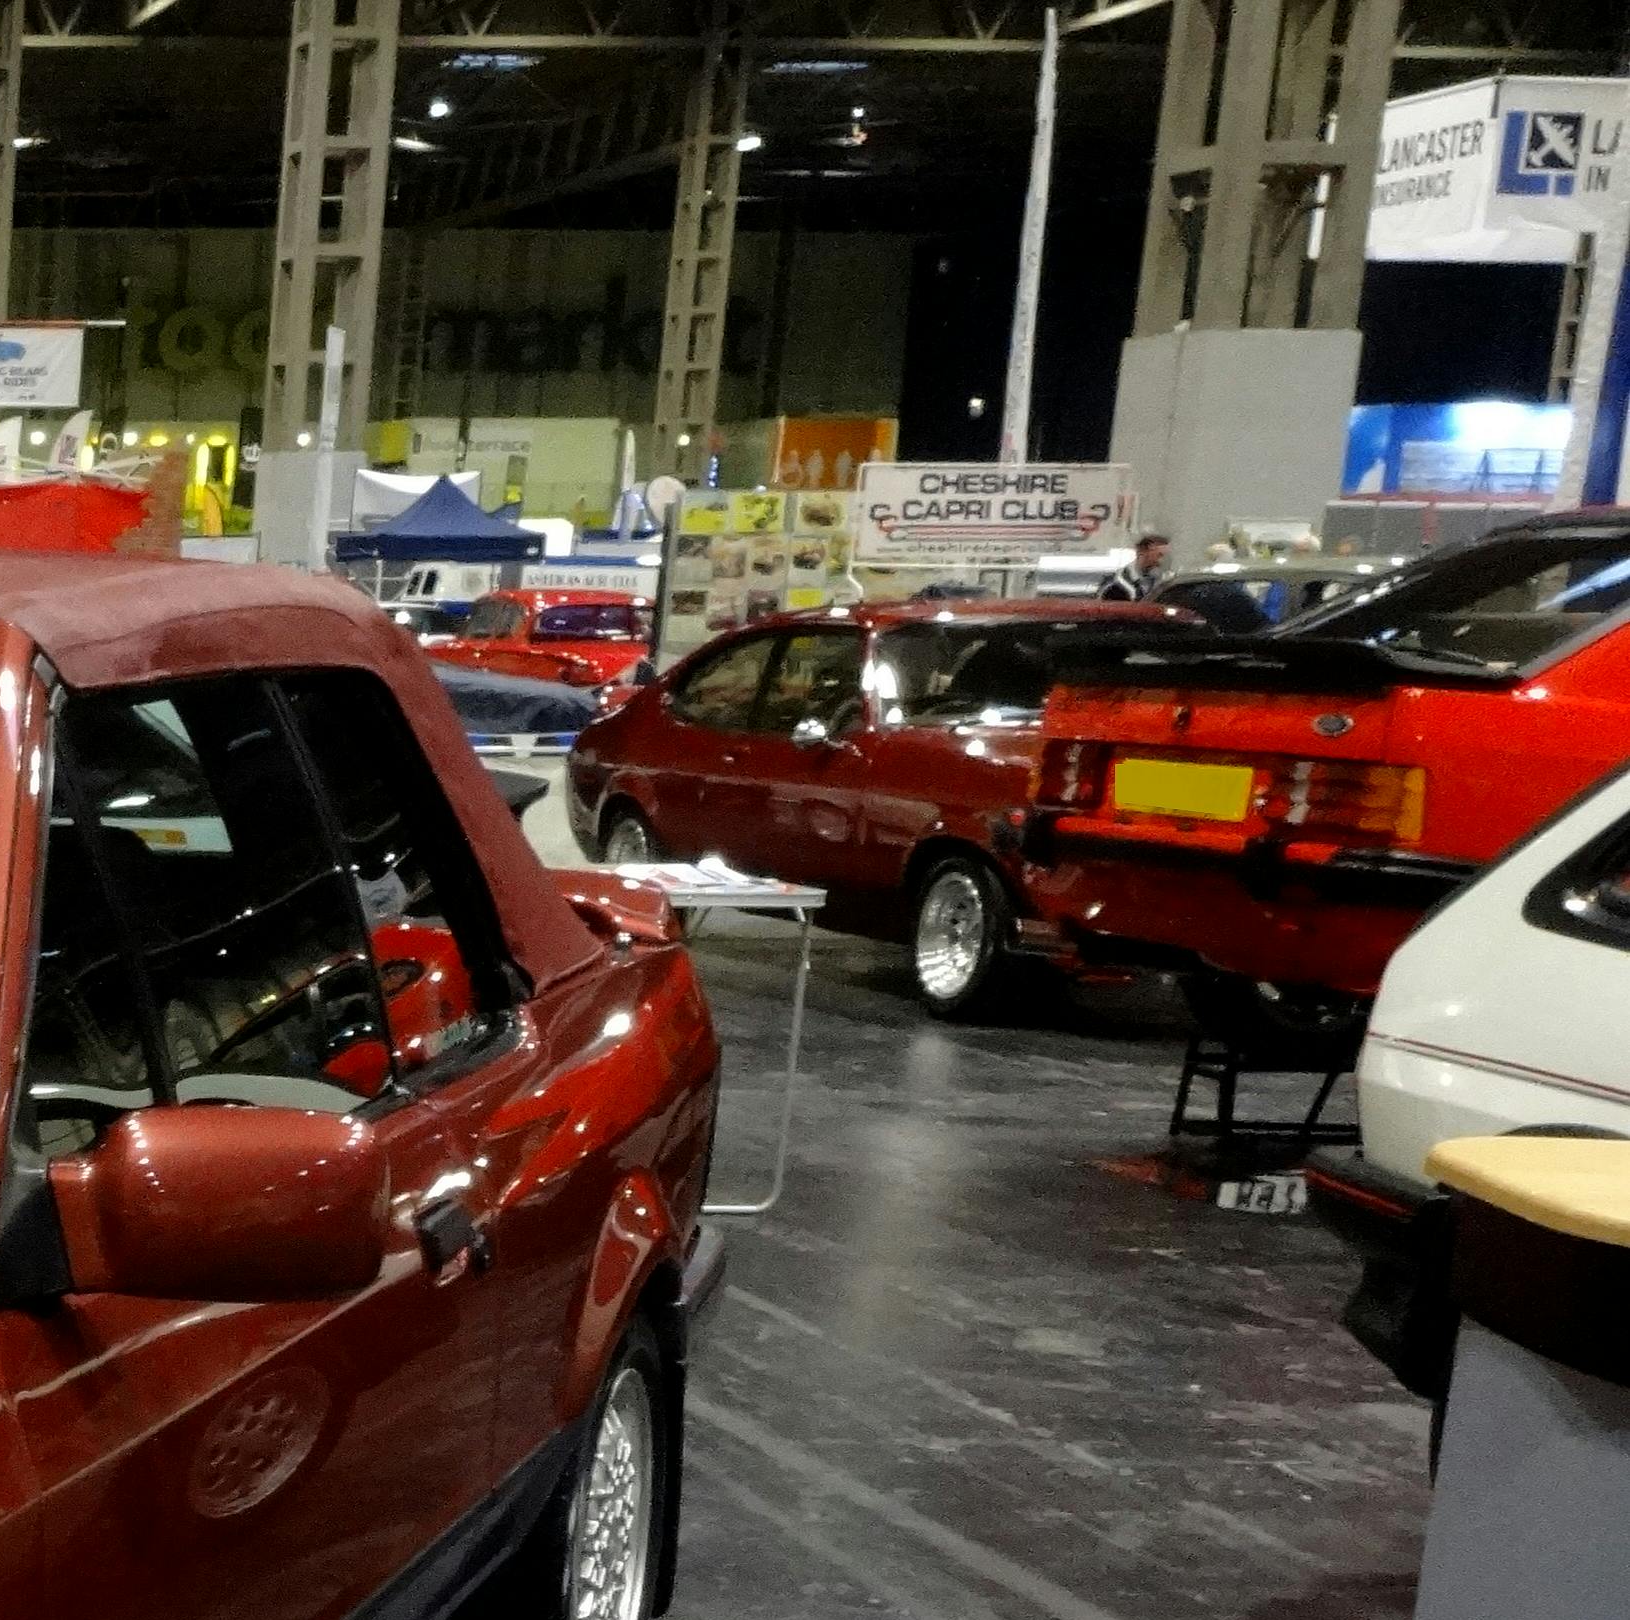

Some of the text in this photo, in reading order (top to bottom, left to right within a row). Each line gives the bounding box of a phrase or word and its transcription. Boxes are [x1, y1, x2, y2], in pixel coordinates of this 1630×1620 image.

[1378, 119, 1485, 173] LANCASTER
[919, 473, 1069, 495] CHESHIRE
[902, 500, 1079, 521] CAPRI CLUB
